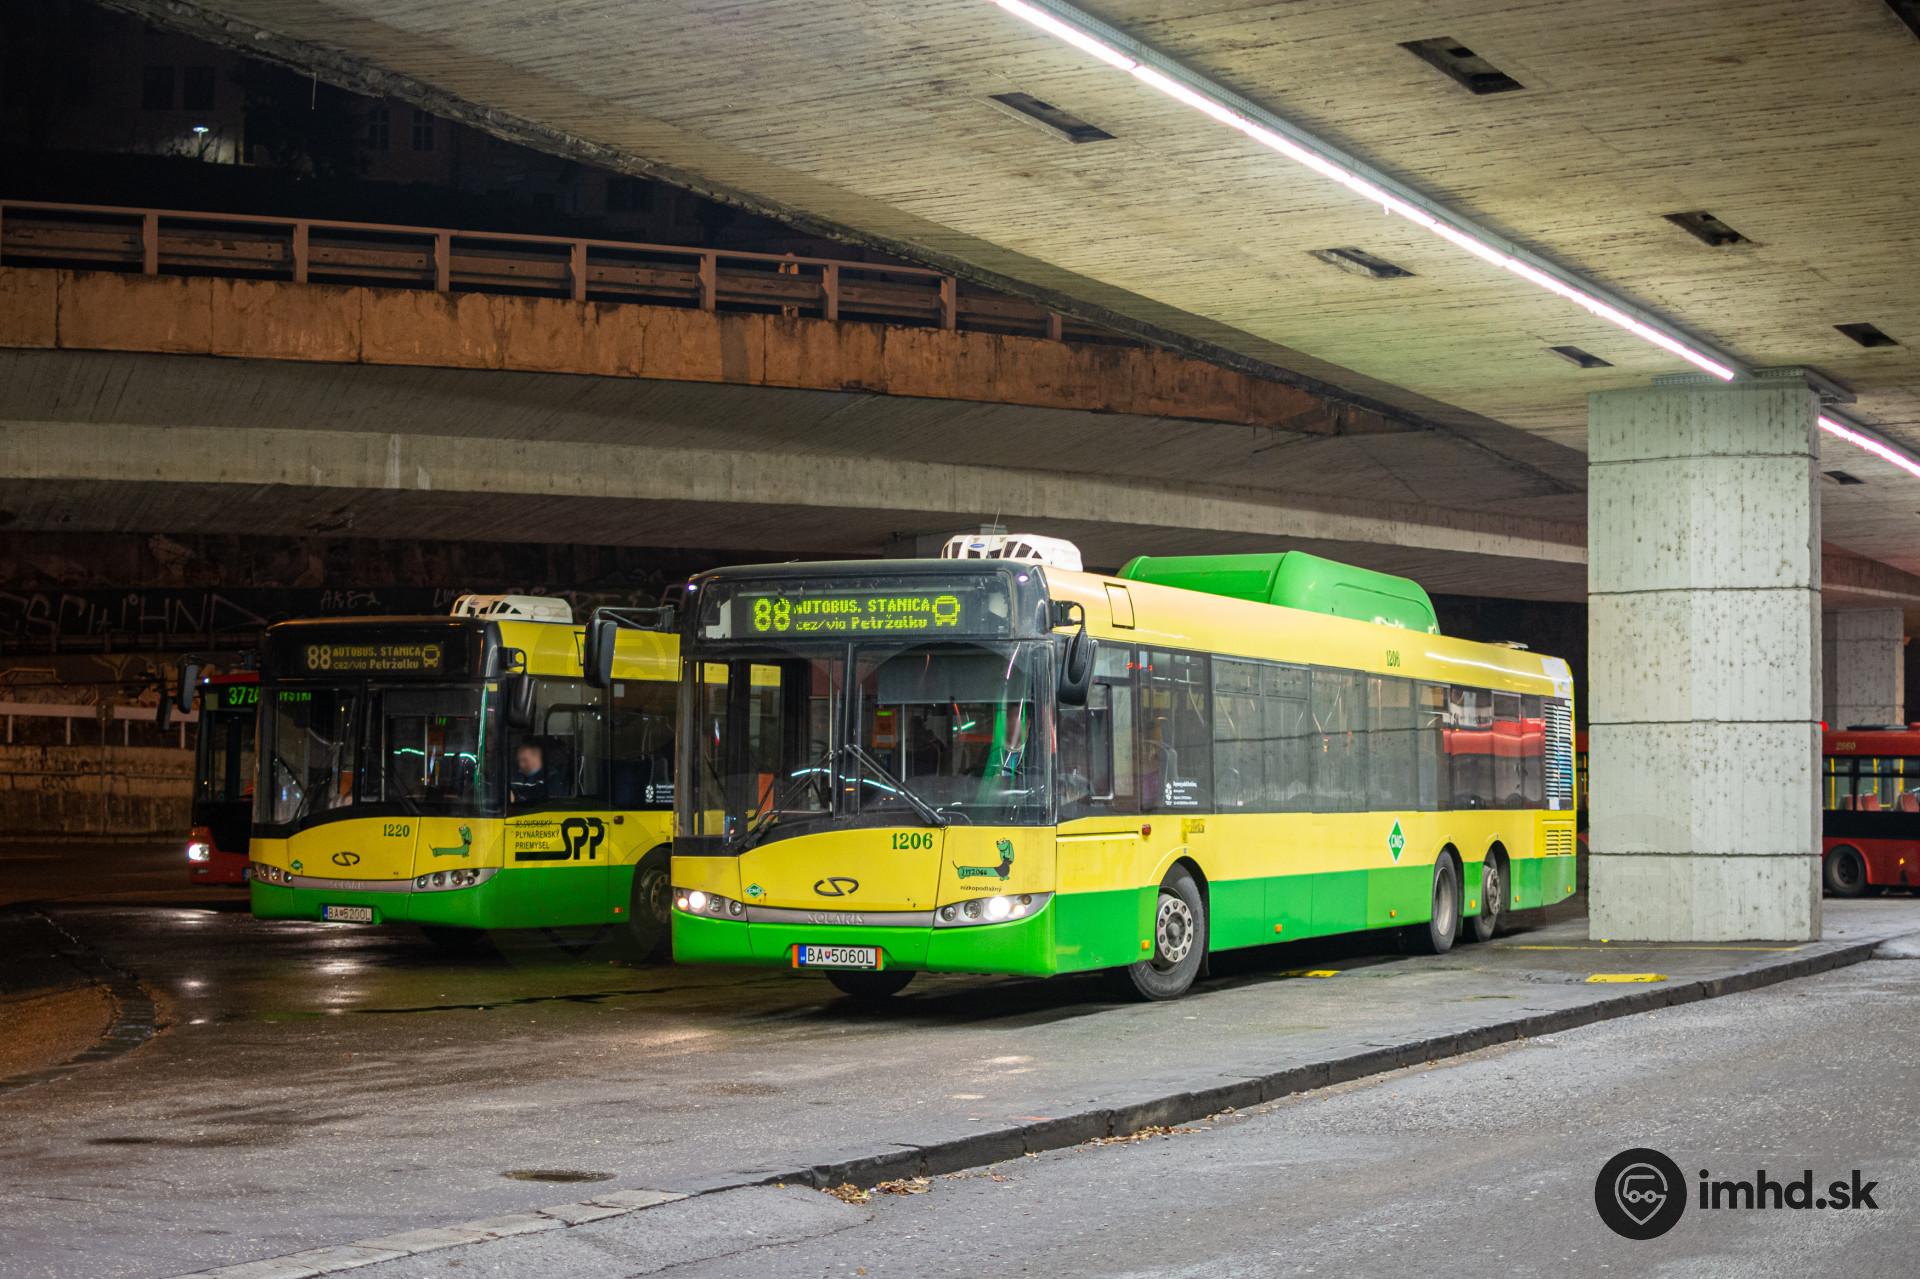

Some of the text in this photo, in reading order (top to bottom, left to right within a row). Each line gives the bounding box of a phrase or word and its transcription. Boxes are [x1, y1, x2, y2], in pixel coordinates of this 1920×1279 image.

[867, 597, 930, 613] STANICA
[754, 597, 791, 632] 88
[307, 644, 332, 670] 88
[380, 646, 421, 657] STANICA
[228, 686, 247, 705] 37
[383, 824, 410, 838] 1220
[550, 817, 605, 860] SPP
[891, 832, 933, 850] 1206
[807, 912, 865, 925] SOLARIS
